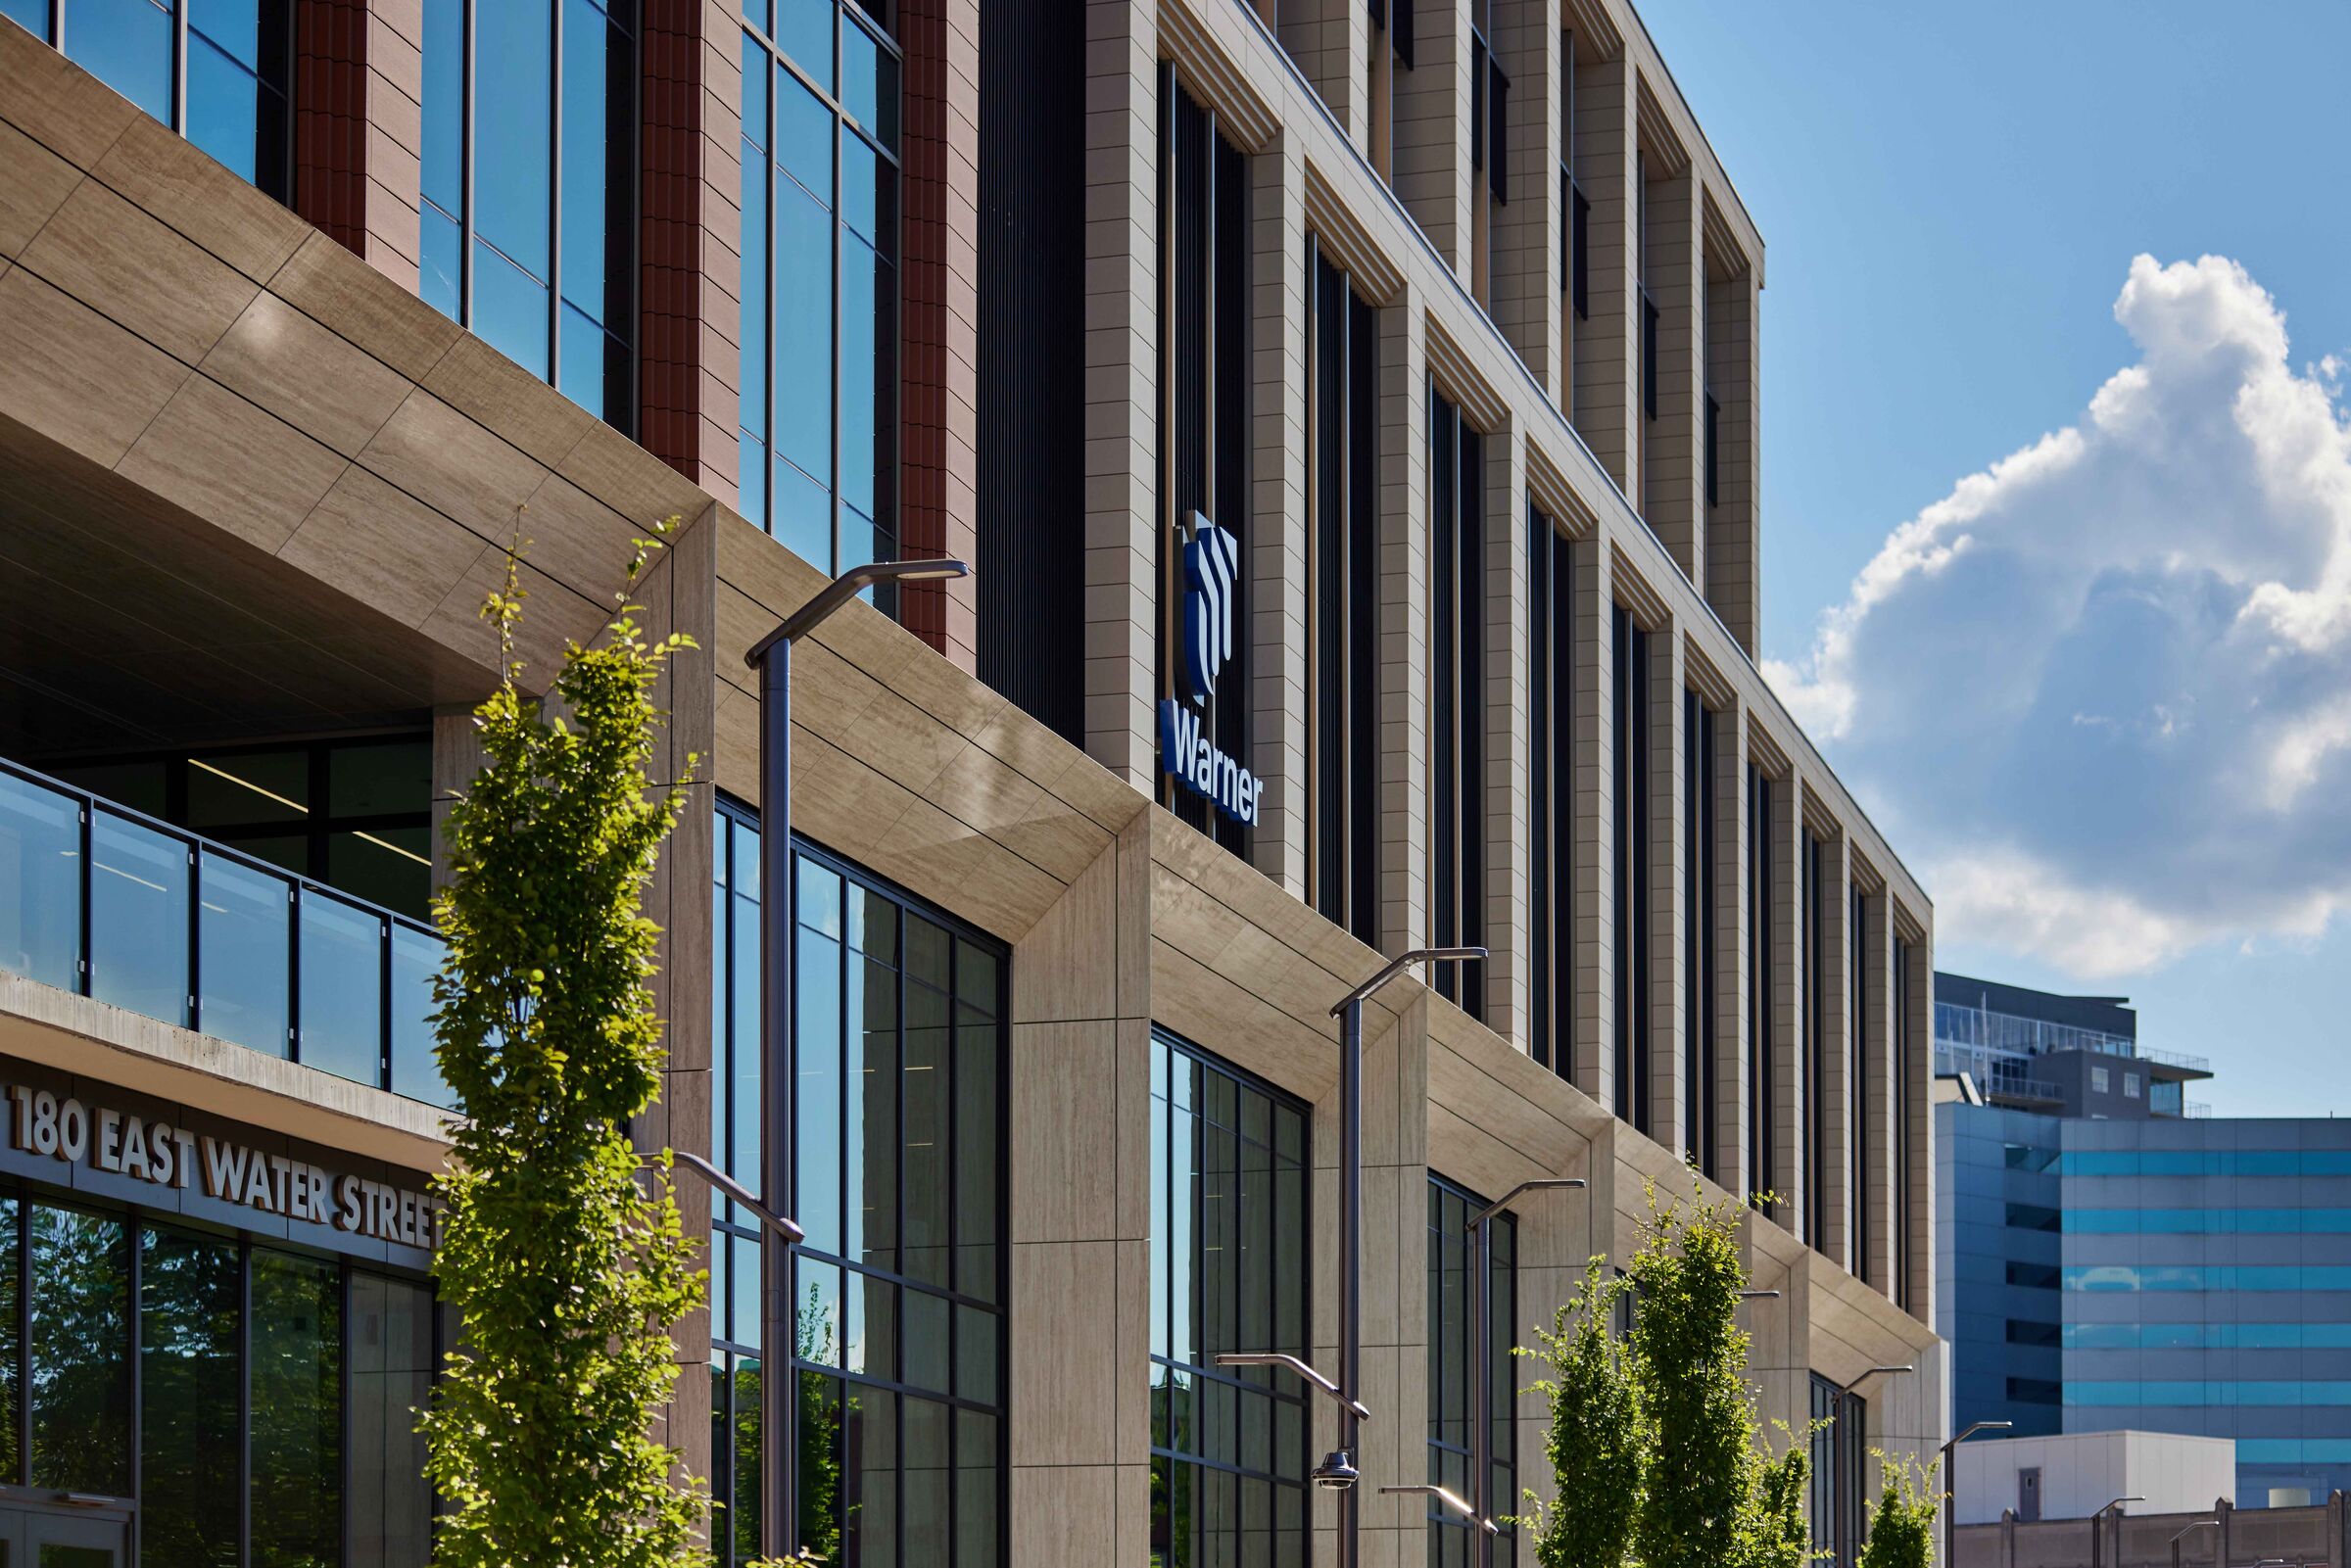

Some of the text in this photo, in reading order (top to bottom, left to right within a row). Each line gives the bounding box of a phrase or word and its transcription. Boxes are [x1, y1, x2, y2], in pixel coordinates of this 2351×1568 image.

[1171, 698, 1264, 828] Warner
[10, 1085, 448, 1249] 180 EAST WATER STREET
